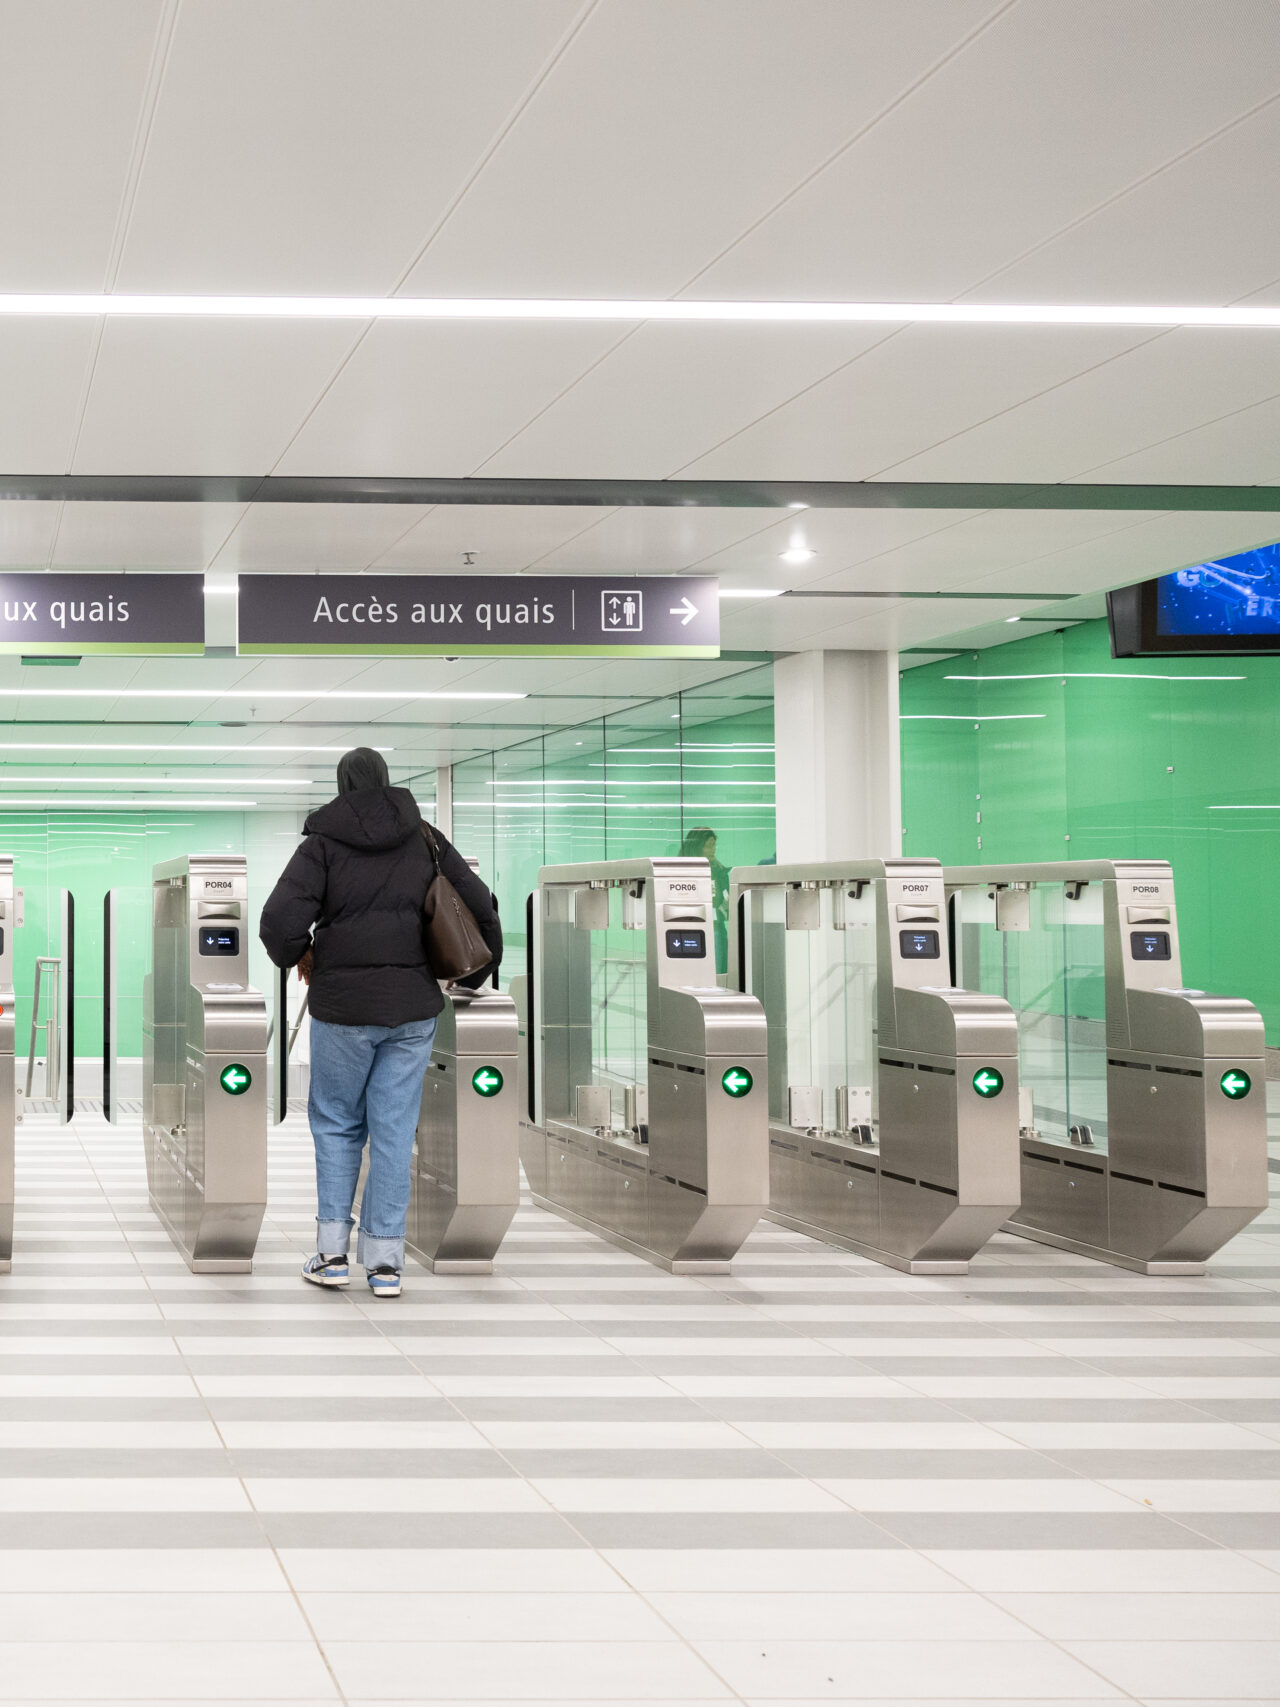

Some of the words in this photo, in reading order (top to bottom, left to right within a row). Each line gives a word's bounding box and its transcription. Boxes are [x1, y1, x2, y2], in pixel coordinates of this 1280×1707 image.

[49, 595, 130, 630] quais
[312, 594, 399, 624] Accès
[410, 603, 464, 624] aux
[475, 596, 556, 631] quais
[205, 881, 233, 889] POR04
[669, 884, 697, 892] POR06
[902, 884, 929, 892] POR07
[1132, 886, 1160, 894] POR08
